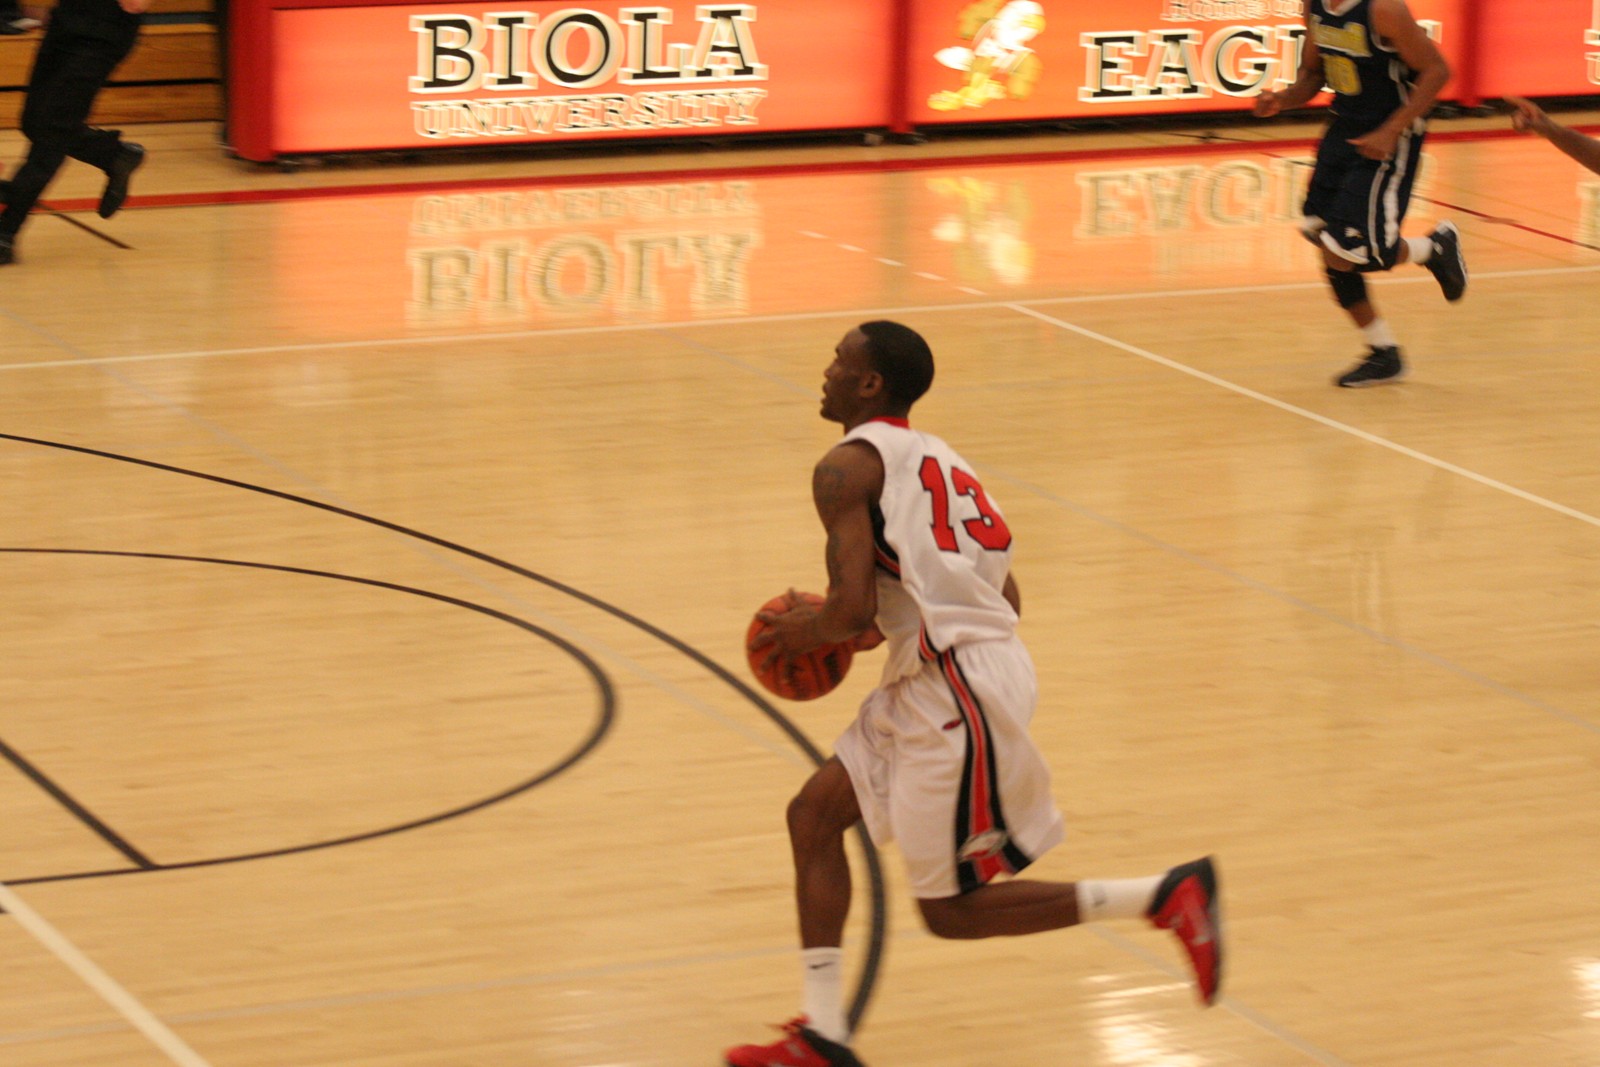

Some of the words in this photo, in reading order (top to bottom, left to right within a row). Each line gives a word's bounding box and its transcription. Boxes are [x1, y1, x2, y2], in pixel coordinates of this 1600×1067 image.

[408, 4, 768, 93] BIOLA
[410, 88, 768, 139] UNIVERSITY
[918, 455, 1012, 554] 13
